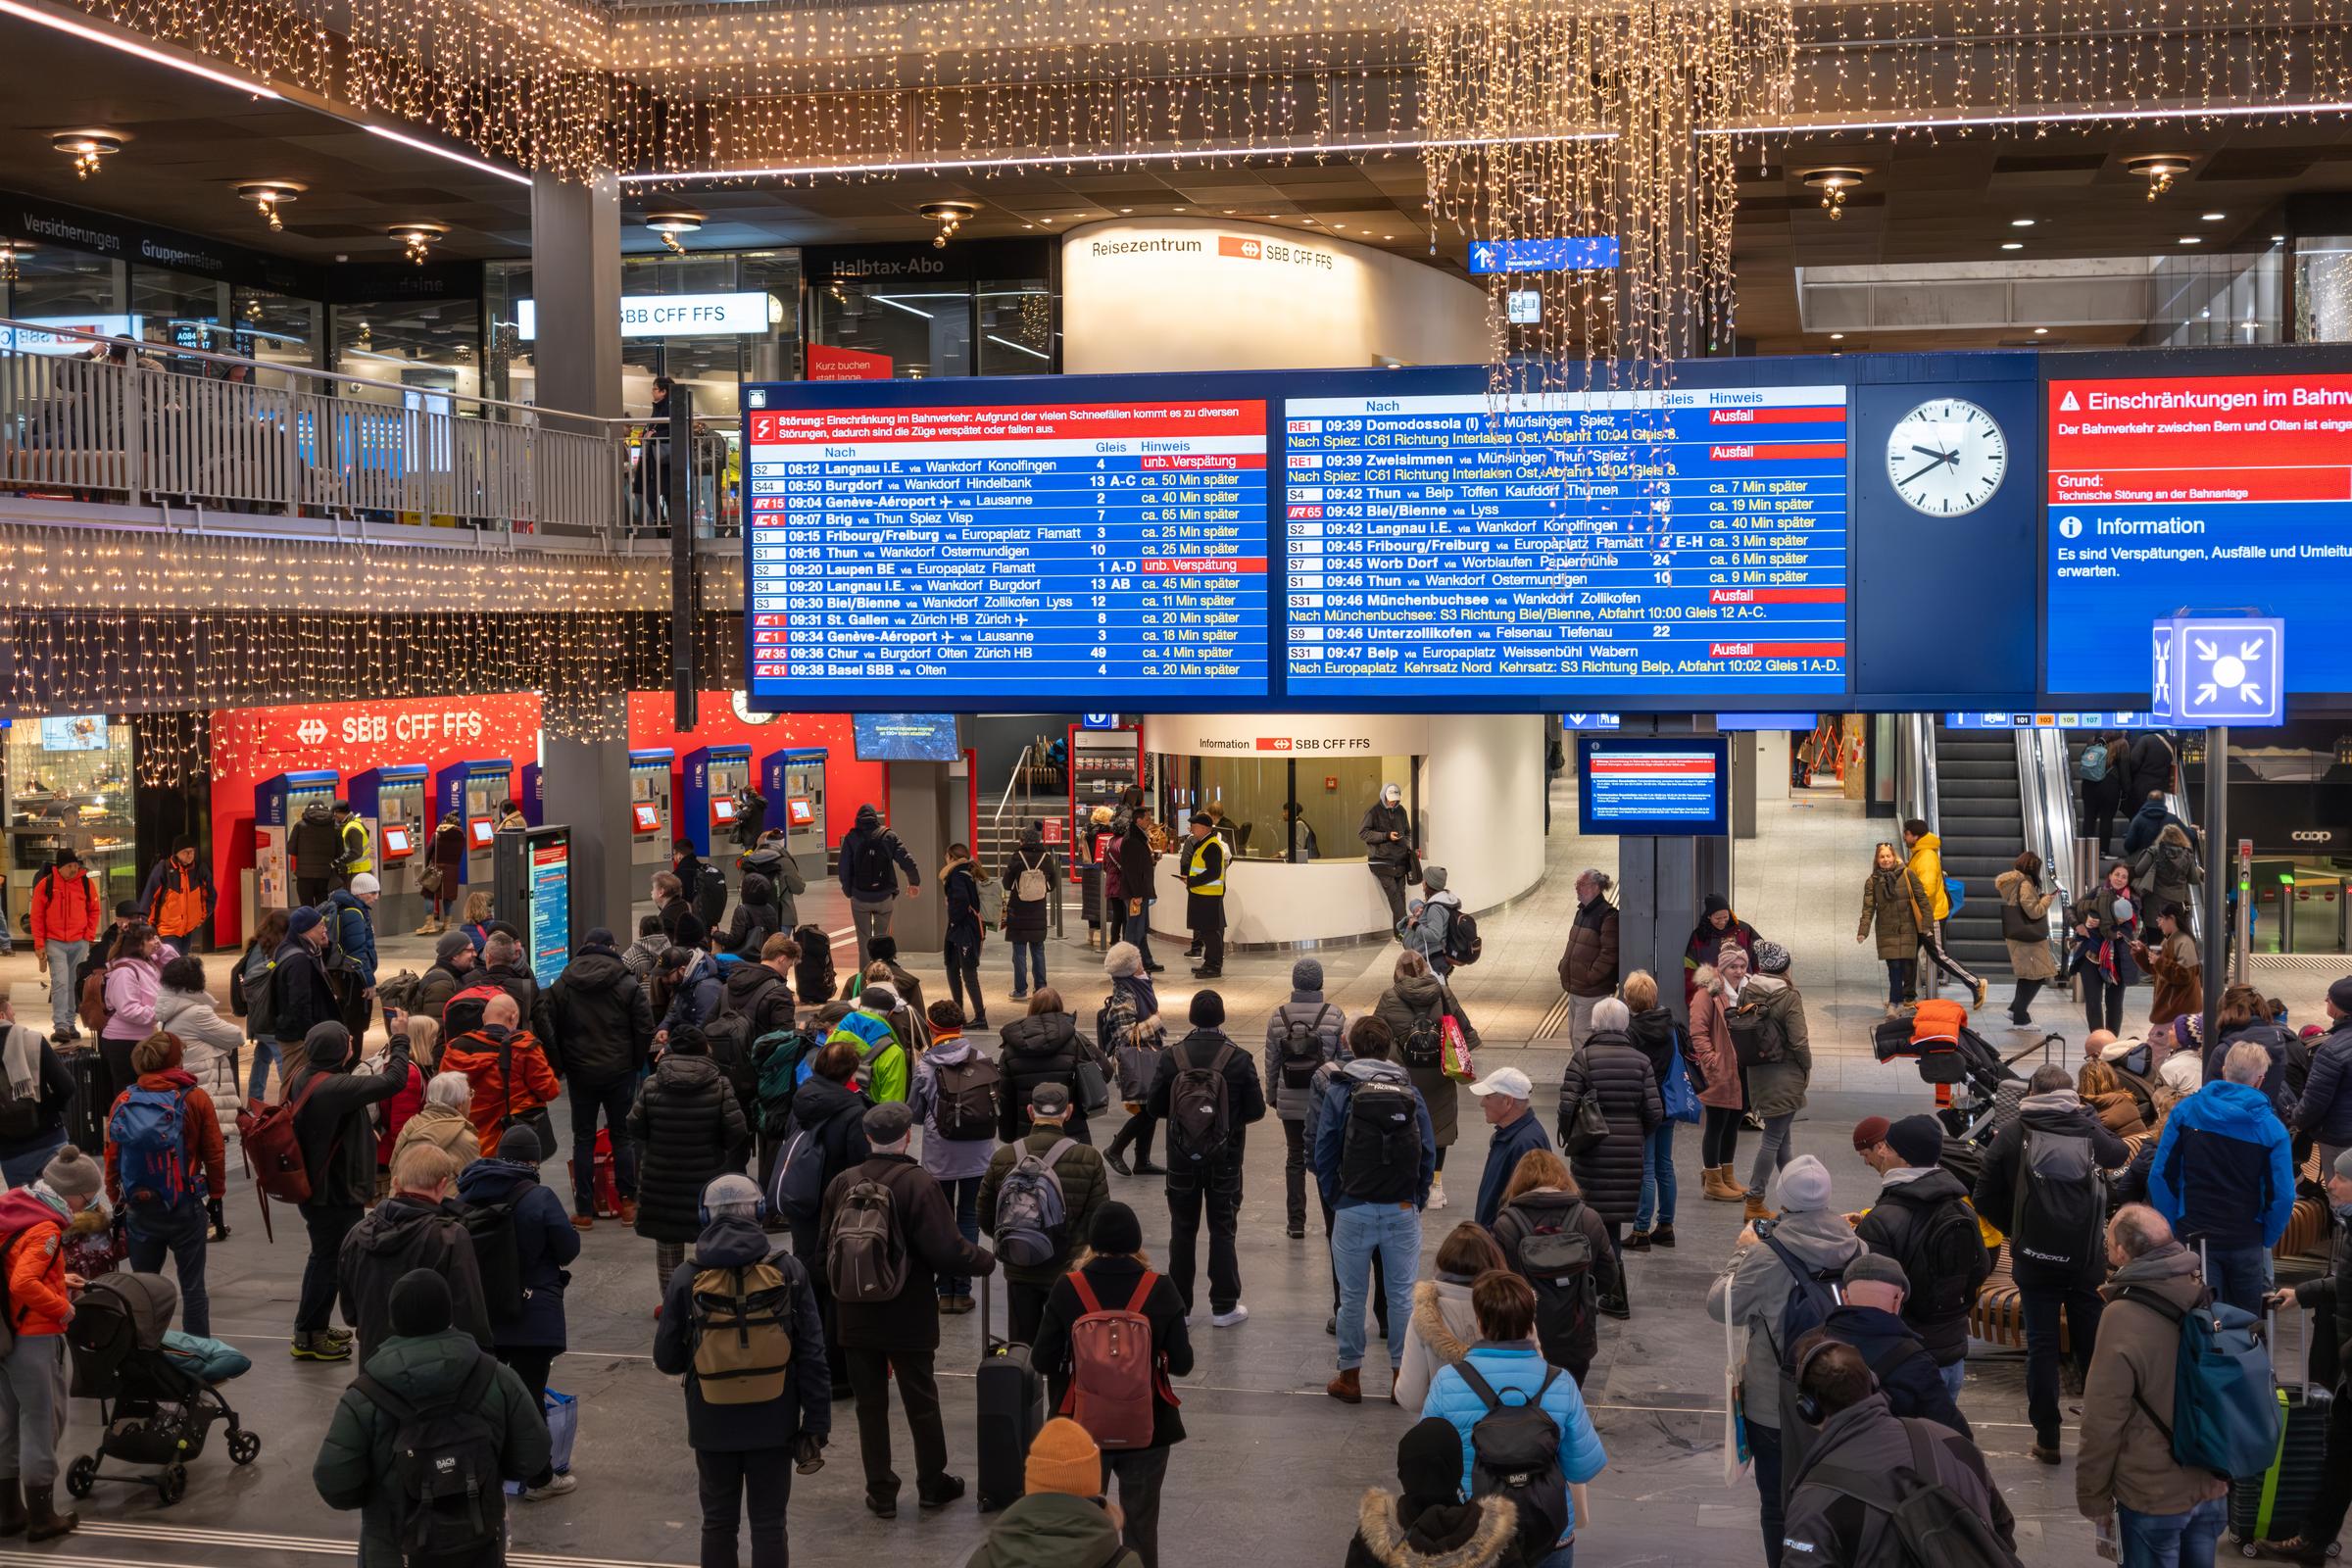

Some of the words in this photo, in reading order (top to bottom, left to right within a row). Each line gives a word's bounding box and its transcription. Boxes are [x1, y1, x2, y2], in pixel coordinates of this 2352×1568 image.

[23, 212, 121, 251] Versicherungen
[141, 239, 223, 270] Gruppenreisen
[1093, 237, 1201, 257] Reisezentrum
[1266, 245, 1290, 262] SBB
[1294, 249, 1312, 266] CFF
[1315, 252, 1333, 270] FFS
[833, 257, 944, 276] Halbtax-Abo
[654, 308, 686, 323] CFF
[694, 306, 725, 321] FFS
[815, 362, 835, 370] Kurz
[838, 361, 870, 369] buchen
[2088, 391, 2257, 410] Einschränkungen
[2263, 388, 2286, 406] im
[778, 416, 824, 427] Störung:
[826, 415, 895, 425] Einschränkung
[897, 414, 908, 423] im
[910, 413, 972, 423] Bahnverkehr:
[974, 412, 1018, 423] Aufgrund
[1020, 411, 1037, 420] der
[1039, 411, 1067, 420] vielen
[1069, 409, 1131, 419] Schneefällen
[1133, 409, 1167, 418] kommt
[1169, 409, 1182, 417] es
[1183, 409, 1196, 417] zu
[1198, 407, 1239, 416] diversen
[778, 428, 829, 440] Störungen,
[831, 427, 870, 437] dadurch
[871, 426, 892, 436] sind
[894, 426, 909, 436] die
[911, 425, 936, 438] Züge
[938, 425, 981, 437] verspätet
[984, 425, 1006, 434] oder
[1007, 423, 1033, 434] fallen
[2058, 422, 2080, 435] Der
[2082, 421, 2155, 434] Bahnverkehr
[2158, 420, 2211, 433] zwischen
[2213, 419, 2241, 431] Bern
[2243, 419, 2266, 431] und
[2269, 418, 2301, 430] Olten
[2303, 418, 2318, 430] ist
[825, 447, 855, 457] Nach
[1096, 442, 1126, 452] Gleis
[1141, 441, 1190, 451] Hinweis
[754, 482, 774, 492] S44
[788, 479, 821, 491] 08:50
[825, 479, 882, 492] Burgdorf
[905, 477, 959, 489] Wankdorf
[966, 477, 1032, 488] Hindelbank
[1090, 475, 1104, 486] 13
[1109, 474, 1135, 486] A-C
[1141, 476, 1157, 486] ca.
[1161, 473, 1176, 485] 50
[1179, 473, 1200, 485] Min
[1203, 473, 1239, 487] später
[2057, 474, 2103, 487] Grund:
[2057, 490, 2112, 500] Technische
[2114, 489, 2153, 501] Störung
[2154, 490, 2168, 499] an
[2170, 489, 2186, 499] der
[2189, 488, 2249, 501] Bahnanlage
[755, 532, 768, 542] S1
[789, 530, 820, 541] 09:15
[826, 529, 939, 543] Fribourg/Freiburg
[961, 528, 1030, 541] Europaplatz
[1037, 527, 1081, 538] Flamatt
[1097, 526, 1105, 538] 3
[1142, 528, 1158, 537] ca.
[1161, 525, 1176, 537] 25
[1179, 525, 1200, 537] Min
[1203, 525, 1239, 539] später
[2097, 517, 2204, 534] Information
[2058, 547, 2076, 560] Es
[2079, 547, 2106, 560] sind
[2110, 547, 2208, 561] Verspätungen,
[2211, 546, 2266, 558] Ausfälle
[2270, 545, 2295, 558] und
[756, 565, 769, 575] S2
[789, 564, 822, 575] 09:20
[826, 564, 872, 576] Laupen
[877, 563, 895, 574] BE
[917, 563, 985, 575] Europaplatz
[992, 562, 1035, 573] Flamatt
[1098, 561, 1103, 572] 1
[1110, 561, 1136, 572] A-D
[1145, 559, 1169, 570] unb.
[1172, 559, 1237, 573] Verspätung
[2057, 564, 2119, 576] erwarten.
[756, 599, 770, 609] S3
[789, 597, 823, 609] 09:30
[827, 597, 901, 610] Biel/Bienne
[922, 596, 978, 608] Wankdorf
[984, 596, 1039, 607] Zollikofen
[1046, 596, 1072, 610] Lyss
[1091, 595, 1105, 607] 12
[1142, 597, 1158, 606] ca.
[1162, 595, 1172, 606] 11
[1176, 595, 1197, 606] Min
[1200, 594, 1236, 608] später
[1289, 610, 1320, 621] Nach
[1324, 610, 1436, 620] Münchenbuchsee:
[1440, 609, 1456, 620] S3
[1460, 609, 1515, 622] Richtung
[1519, 608, 1593, 621] Biel/Bienne,
[1597, 607, 1644, 618] Abfahrt
[1648, 606, 1682, 618] 10:00
[1685, 607, 1717, 617] Gleis
[1721, 606, 1734, 617] 12
[1737, 606, 1766, 617] A-C.
[1290, 629, 1305, 639] S9
[1327, 627, 1363, 639] 09:46
[1367, 626, 1471, 639] Unterzollikofen
[1496, 626, 1551, 638] Felsenau
[1558, 625, 1612, 637] Tiefenau
[1652, 624, 1670, 637] 22
[1290, 649, 1311, 659] S31
[1327, 646, 1362, 659] 09:47
[1367, 646, 1398, 661] Belp
[1423, 646, 1495, 660] Europaplatz
[1502, 646, 1582, 658] Weissenbühl
[1589, 645, 1638, 657] Wabern
[1712, 642, 1753, 655] Ausfall
[342, 715, 388, 744] SBB
[395, 713, 436, 741] CFF
[443, 710, 482, 738] FFS
[1200, 738, 1250, 749] Information
[1296, 739, 1320, 750] SBB
[1323, 739, 1346, 749] CFF
[1349, 738, 1370, 749] FFS
[2291, 831, 2331, 843] coop
[436, 1457, 455, 1469] BACH
[1509, 1473, 1527, 1483] BACH
